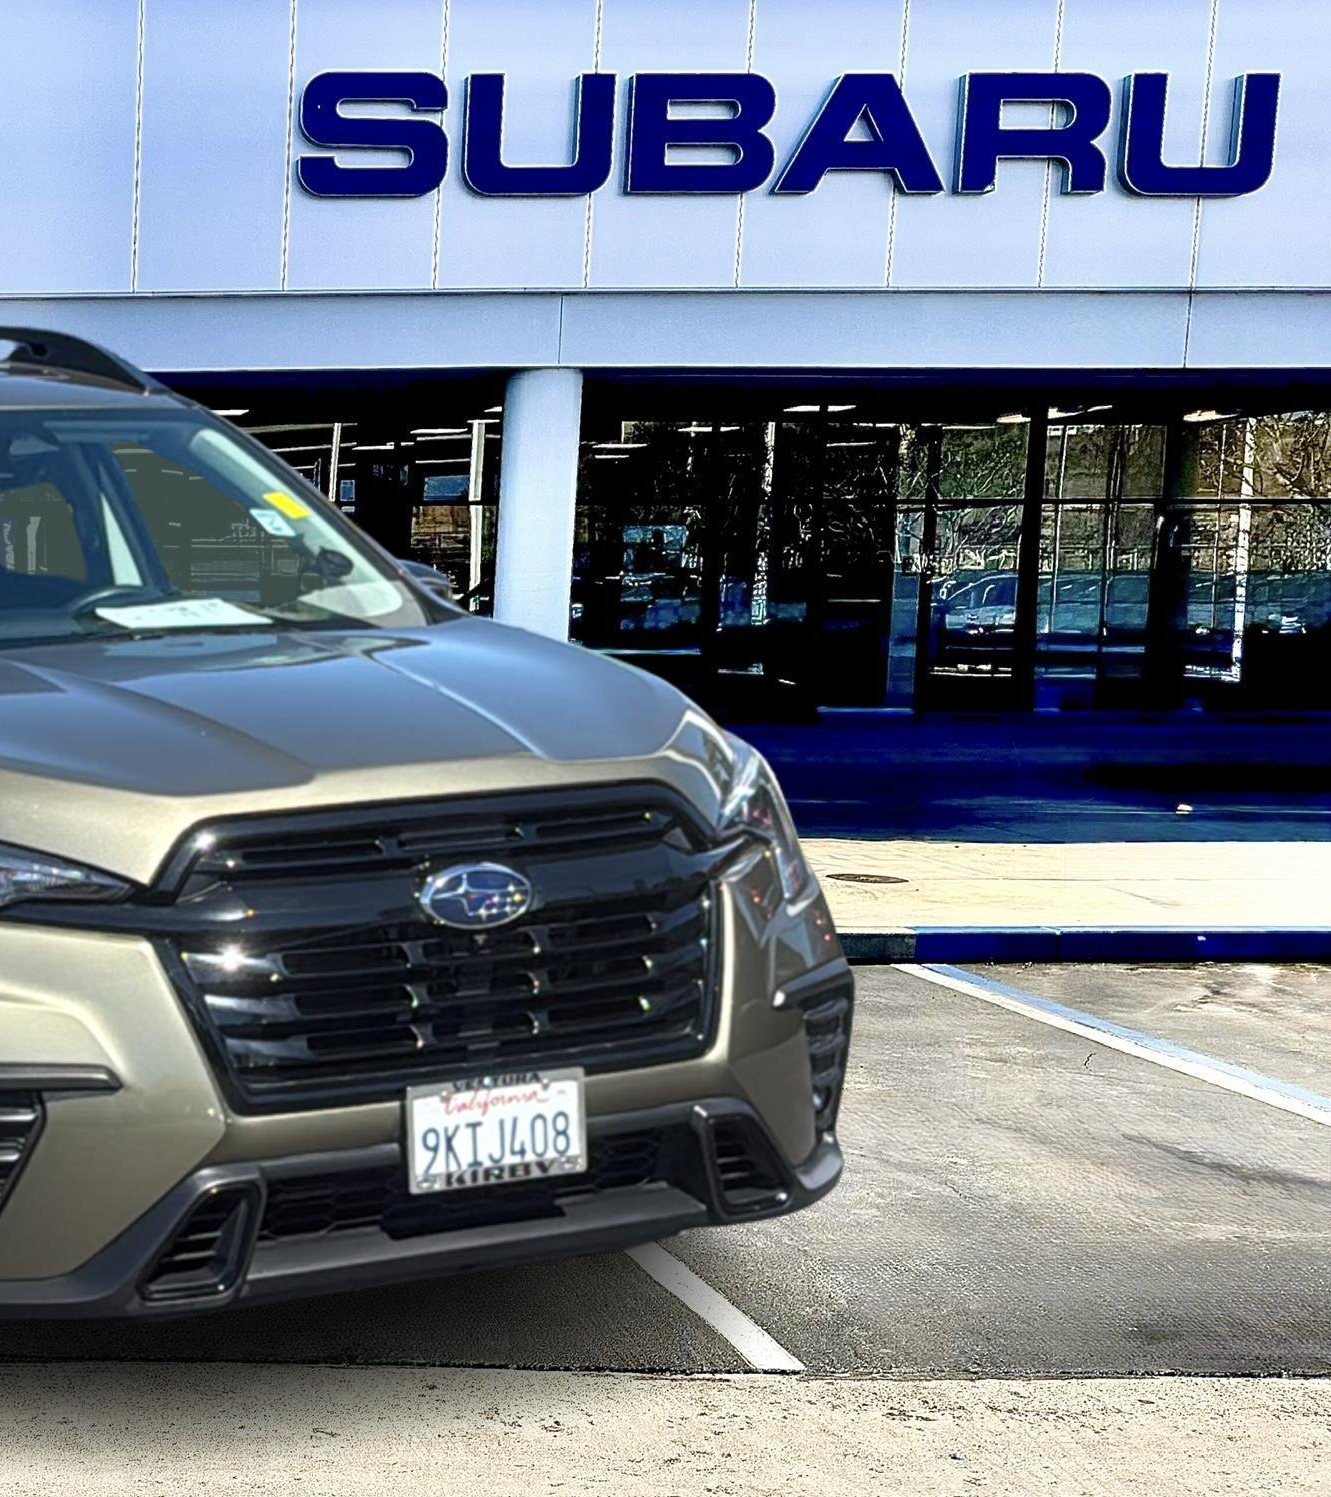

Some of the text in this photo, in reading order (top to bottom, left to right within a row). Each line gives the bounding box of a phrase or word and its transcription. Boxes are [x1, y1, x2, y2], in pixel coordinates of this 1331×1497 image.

[297, 71, 1280, 197] SUBARU
[442, 1087, 550, 1117] California
[422, 1110, 571, 1178] 9KIJ408
[445, 1160, 556, 1188] KIRBY
